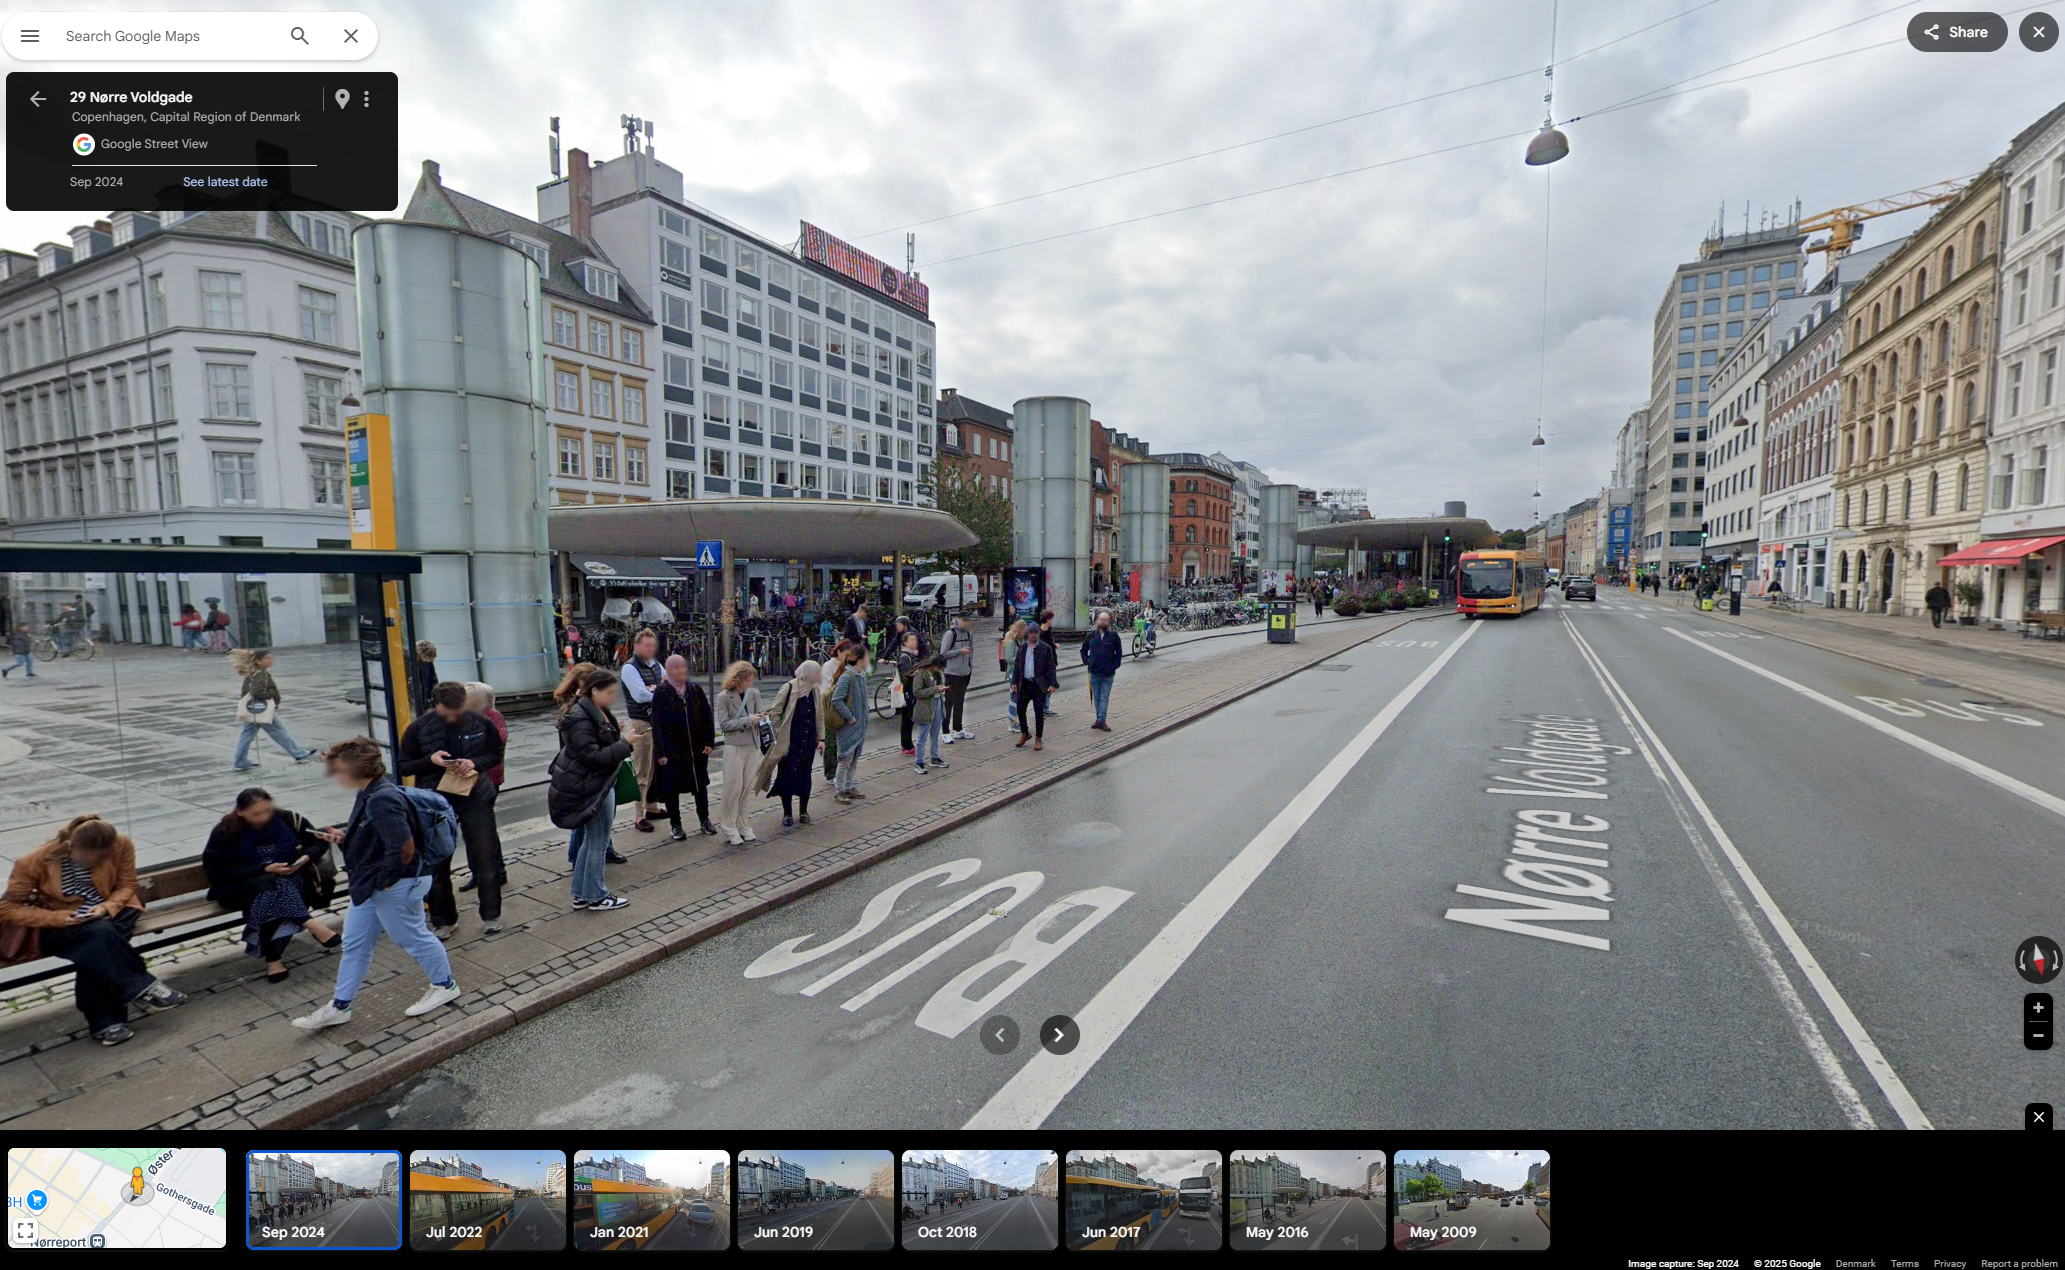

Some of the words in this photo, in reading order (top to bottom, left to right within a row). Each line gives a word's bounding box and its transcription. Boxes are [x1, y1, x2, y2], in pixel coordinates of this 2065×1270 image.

[1376, 640, 1440, 648] BUS
[1854, 696, 2044, 727] BUS
[1485, 714, 1632, 799] Voldgade
[1444, 809, 1616, 951] Nørre
[744, 858, 1136, 1039] BUS
